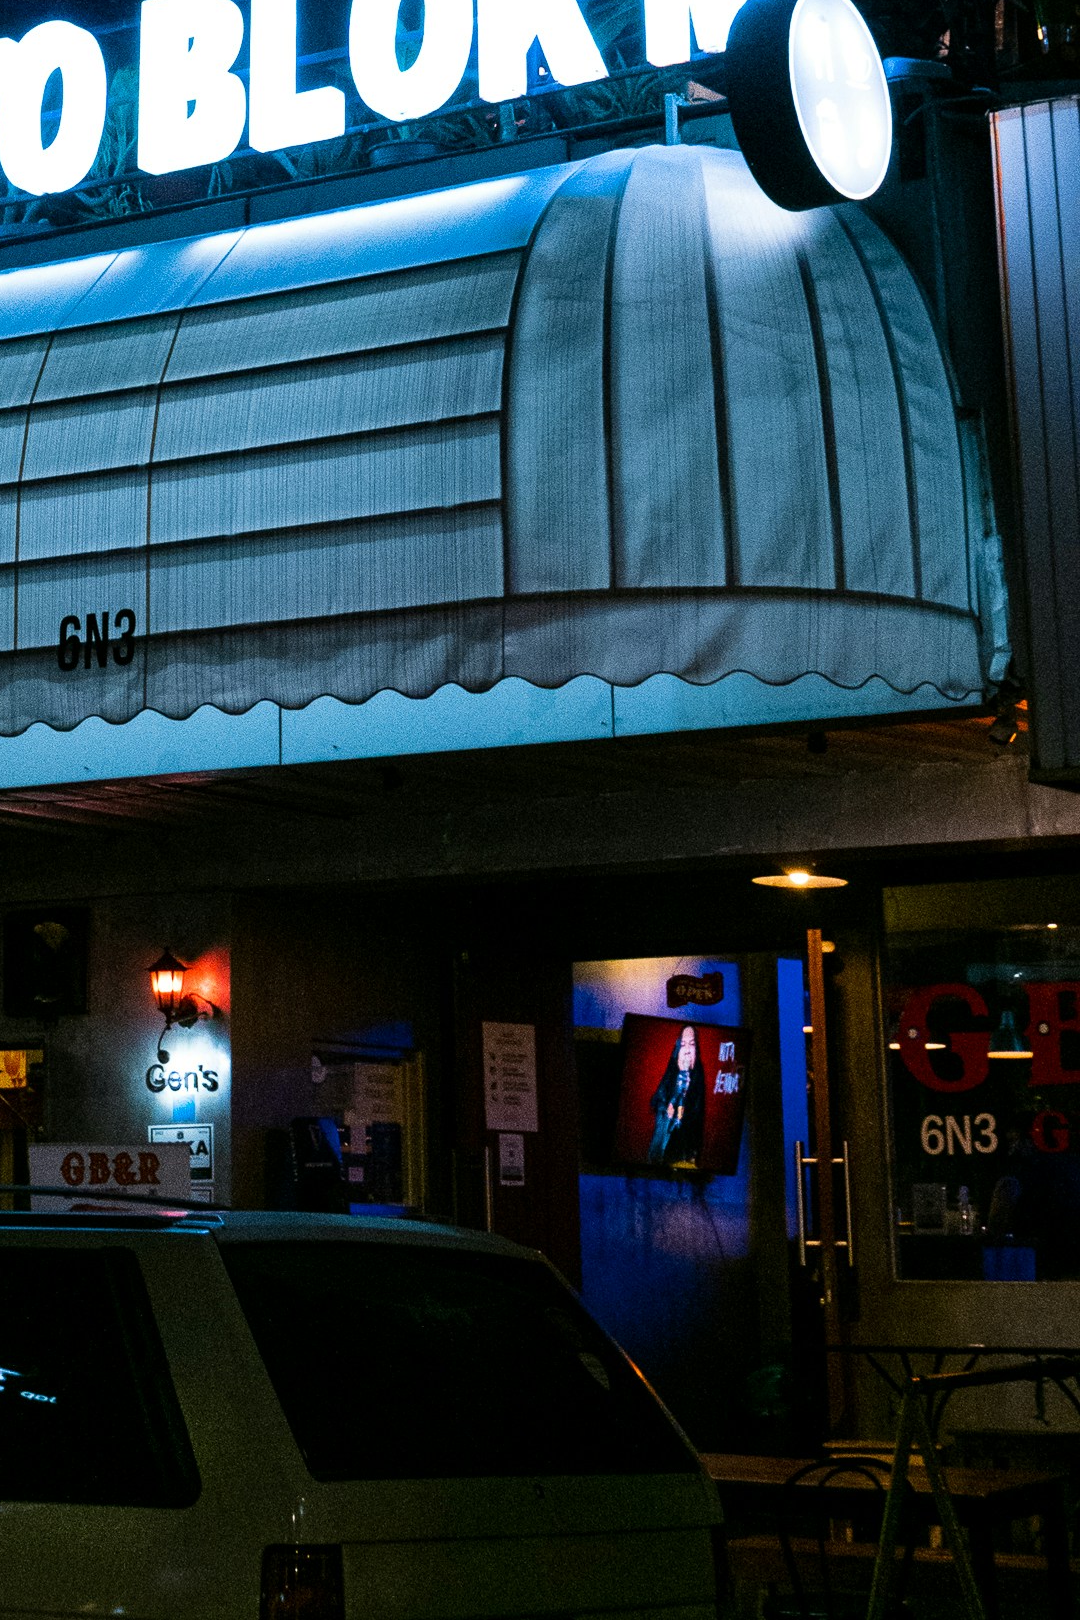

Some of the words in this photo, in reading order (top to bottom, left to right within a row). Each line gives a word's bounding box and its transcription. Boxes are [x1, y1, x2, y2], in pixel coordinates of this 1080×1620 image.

[58, 608, 138, 674] 6N3
[145, 1063, 219, 1093] Gen's
[920, 1112, 1000, 1157] 6N3
[60, 1151, 161, 1186] GB&R
